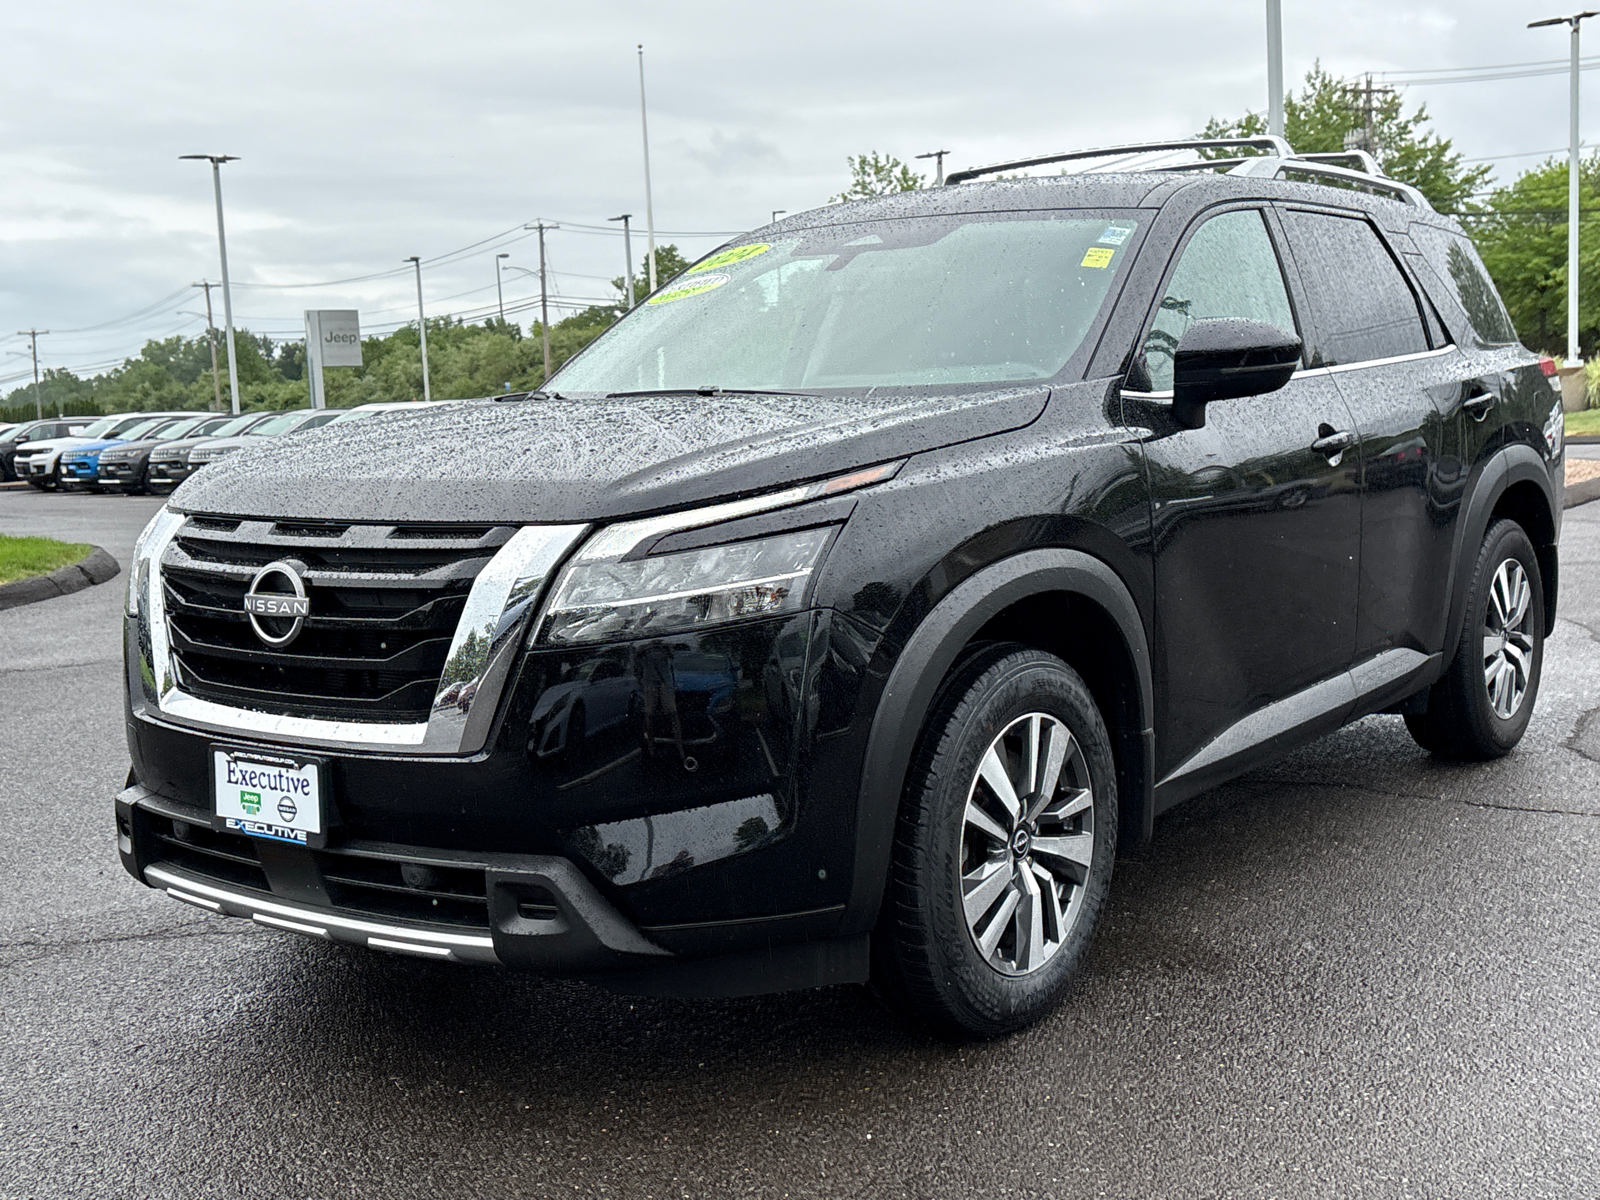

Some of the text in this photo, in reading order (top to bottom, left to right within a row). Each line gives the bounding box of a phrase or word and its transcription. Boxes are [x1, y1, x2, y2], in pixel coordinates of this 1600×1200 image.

[324, 331, 357, 345] Jeep
[244, 598, 307, 614] NISSAN
[226, 759, 310, 796] Executive
[243, 793, 259, 802] Jeep
[226, 818, 307, 841] EXECUTIVE
